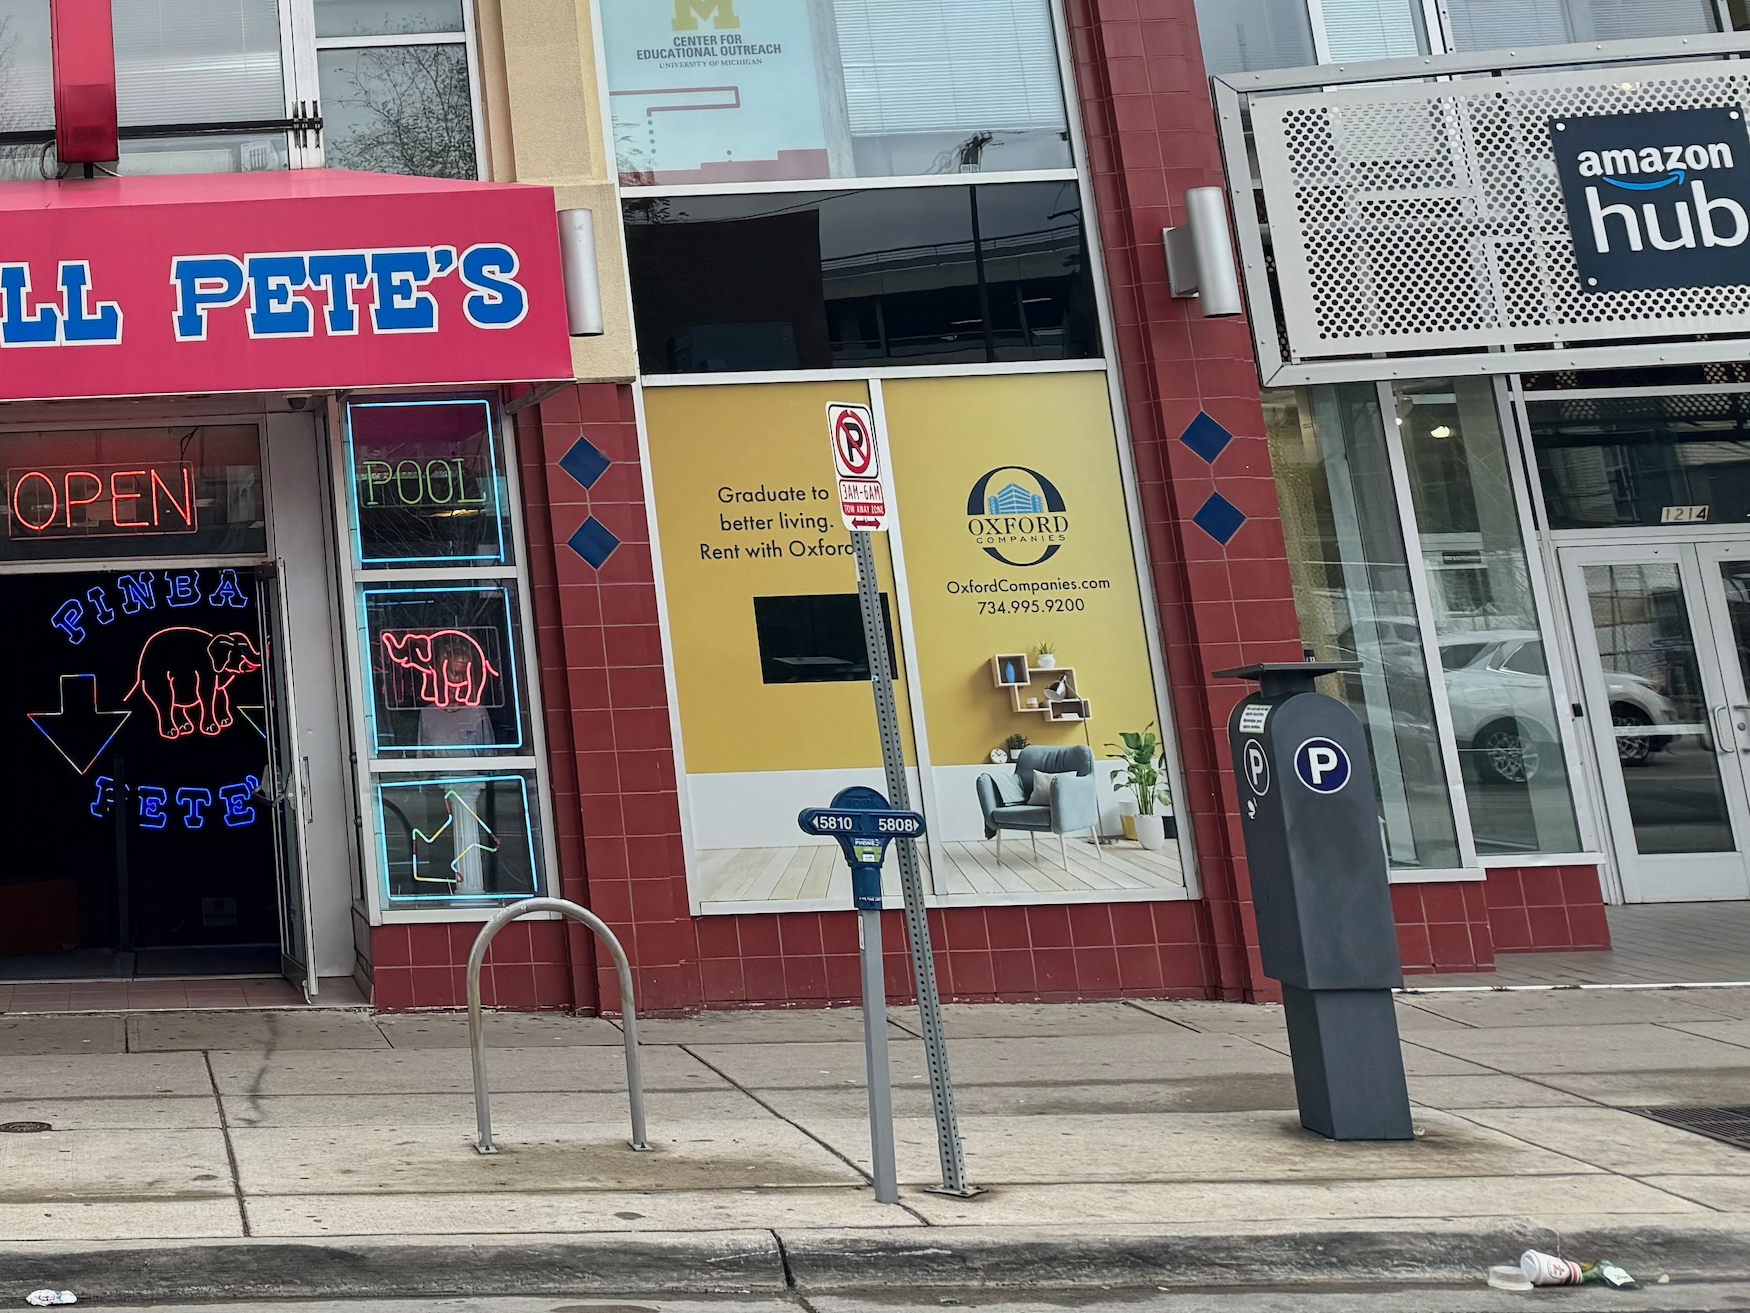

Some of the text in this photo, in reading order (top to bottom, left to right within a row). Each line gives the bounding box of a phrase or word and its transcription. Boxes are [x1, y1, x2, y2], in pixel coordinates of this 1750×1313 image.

[673, 34, 742, 47] CENTER FOR
[636, 44, 782, 60] EDUCATIONAL OUTREACH
[659, 60, 707, 69] UNIVERSITY
[721, 58, 763, 67] MICHIGAN
[1577, 142, 1734, 177] amazon
[1584, 180, 1749, 253] hub
[169, 243, 529, 343] PETE'S
[363, 458, 486, 505] POOL
[13, 468, 192, 531] OPEN
[718, 485, 829, 503] Graduate to
[842, 484, 881, 500] 3AM-6AM
[844, 504, 855, 513] TOW
[856, 504, 870, 514] AWAY
[1666, 507, 1706, 521] 1214
[719, 512, 834, 533] better living.
[968, 516, 1068, 536] OXFORD
[976, 534, 1066, 544] COMPANIES
[700, 543, 740, 560] Rent
[745, 540, 783, 558] with
[947, 577, 1110, 595] OxfordCompanies.com
[977, 598, 1085, 615] 734.995.9200
[1249, 748, 1264, 785] P
[1308, 747, 1338, 785] P
[820, 816, 852, 830] 5810
[878, 818, 913, 831] 5808
